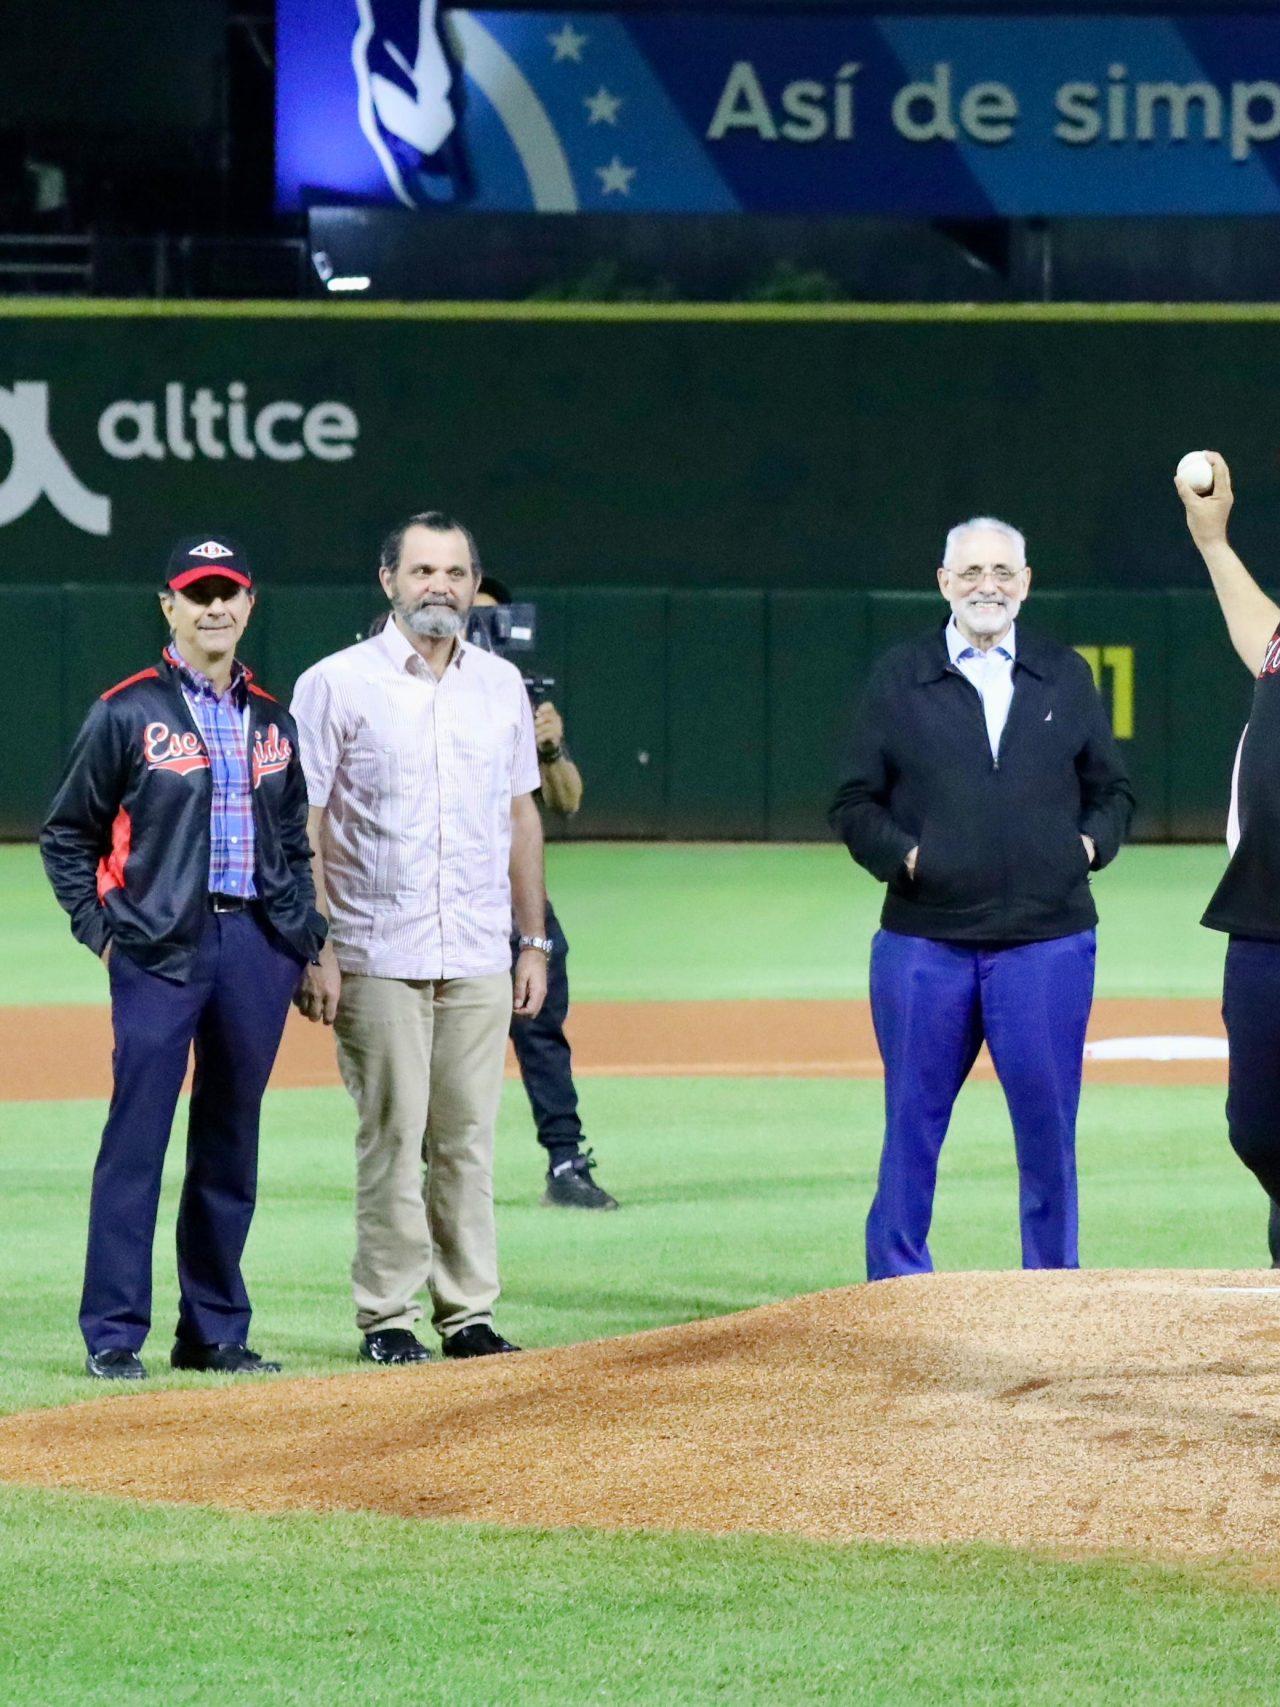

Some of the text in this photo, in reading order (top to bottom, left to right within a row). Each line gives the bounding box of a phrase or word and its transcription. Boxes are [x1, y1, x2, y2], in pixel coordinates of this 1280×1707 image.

[706, 61, 862, 142] Así
[892, 63, 1018, 142] de
[98, 382, 359, 461] altice
